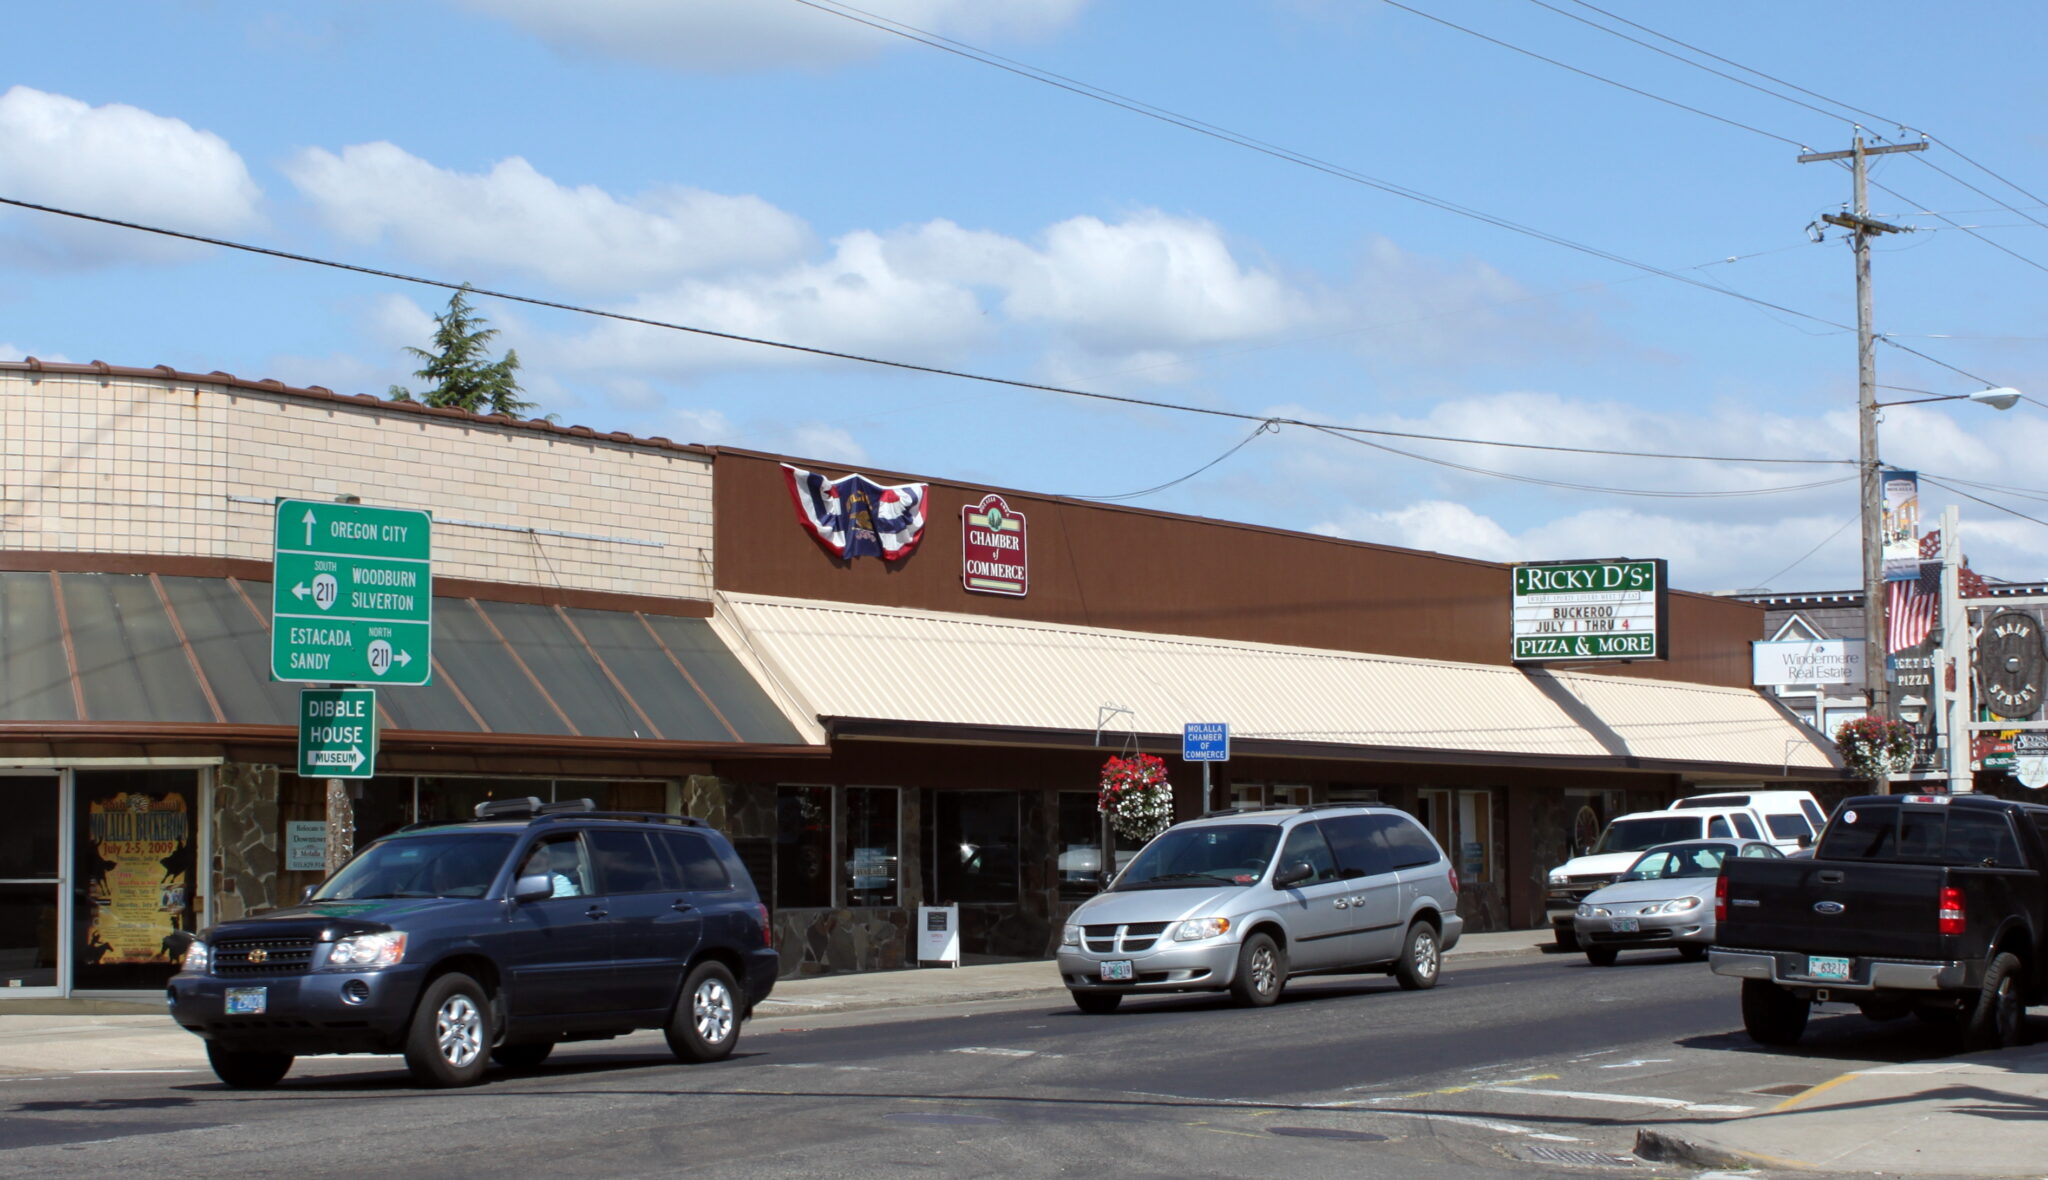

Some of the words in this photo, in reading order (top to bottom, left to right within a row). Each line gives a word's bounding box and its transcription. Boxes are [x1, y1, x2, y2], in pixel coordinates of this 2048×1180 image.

[331, 521, 377, 541] OREGON
[382, 525, 408, 543] CITY
[969, 530, 1020, 551] CHAMBER
[992, 548, 1000, 561] of
[314, 560, 337, 572] SOUTH
[967, 559, 1025, 580] COMMERCE
[352, 567, 416, 588] WOODBURN
[316, 582, 335, 602] 211
[351, 591, 414, 611] SILVERTON
[1553, 606, 1614, 619] BUCKEROO
[368, 627, 392, 638] NORTH
[1536, 621, 1565, 633] JULY
[1585, 619, 1615, 631] THRU
[1621, 618, 1630, 630] 4
[1995, 623, 2030, 638] MAIN
[290, 627, 352, 647] ESTACADA
[1520, 639, 1570, 655] PIZZA
[1575, 636, 1592, 656] &
[1598, 637, 1651, 653] MORE
[290, 652, 331, 670] SANDY
[371, 648, 389, 668] 211
[1782, 653, 1859, 666] Windermere
[1788, 666, 1815, 680] Real
[1816, 665, 1853, 680] Estate
[1898, 674, 1930, 686] PIZZA
[1989, 683, 2037, 706] STREET
[309, 700, 365, 717] DIBBLE
[310, 726, 363, 743] HOUSE
[1187, 725, 1223, 733] MOLALLA
[1187, 733, 1223, 742] CHAMBER
[1200, 742, 1210, 750] OF
[315, 752, 357, 763] MUSEUM
[1185, 750, 1225, 759] COMMERCE
[103, 842, 122, 856] July
[125, 842, 145, 856] 2-5,
[149, 842, 174, 854] 2009
[1821, 962, 1847, 976] 63212
